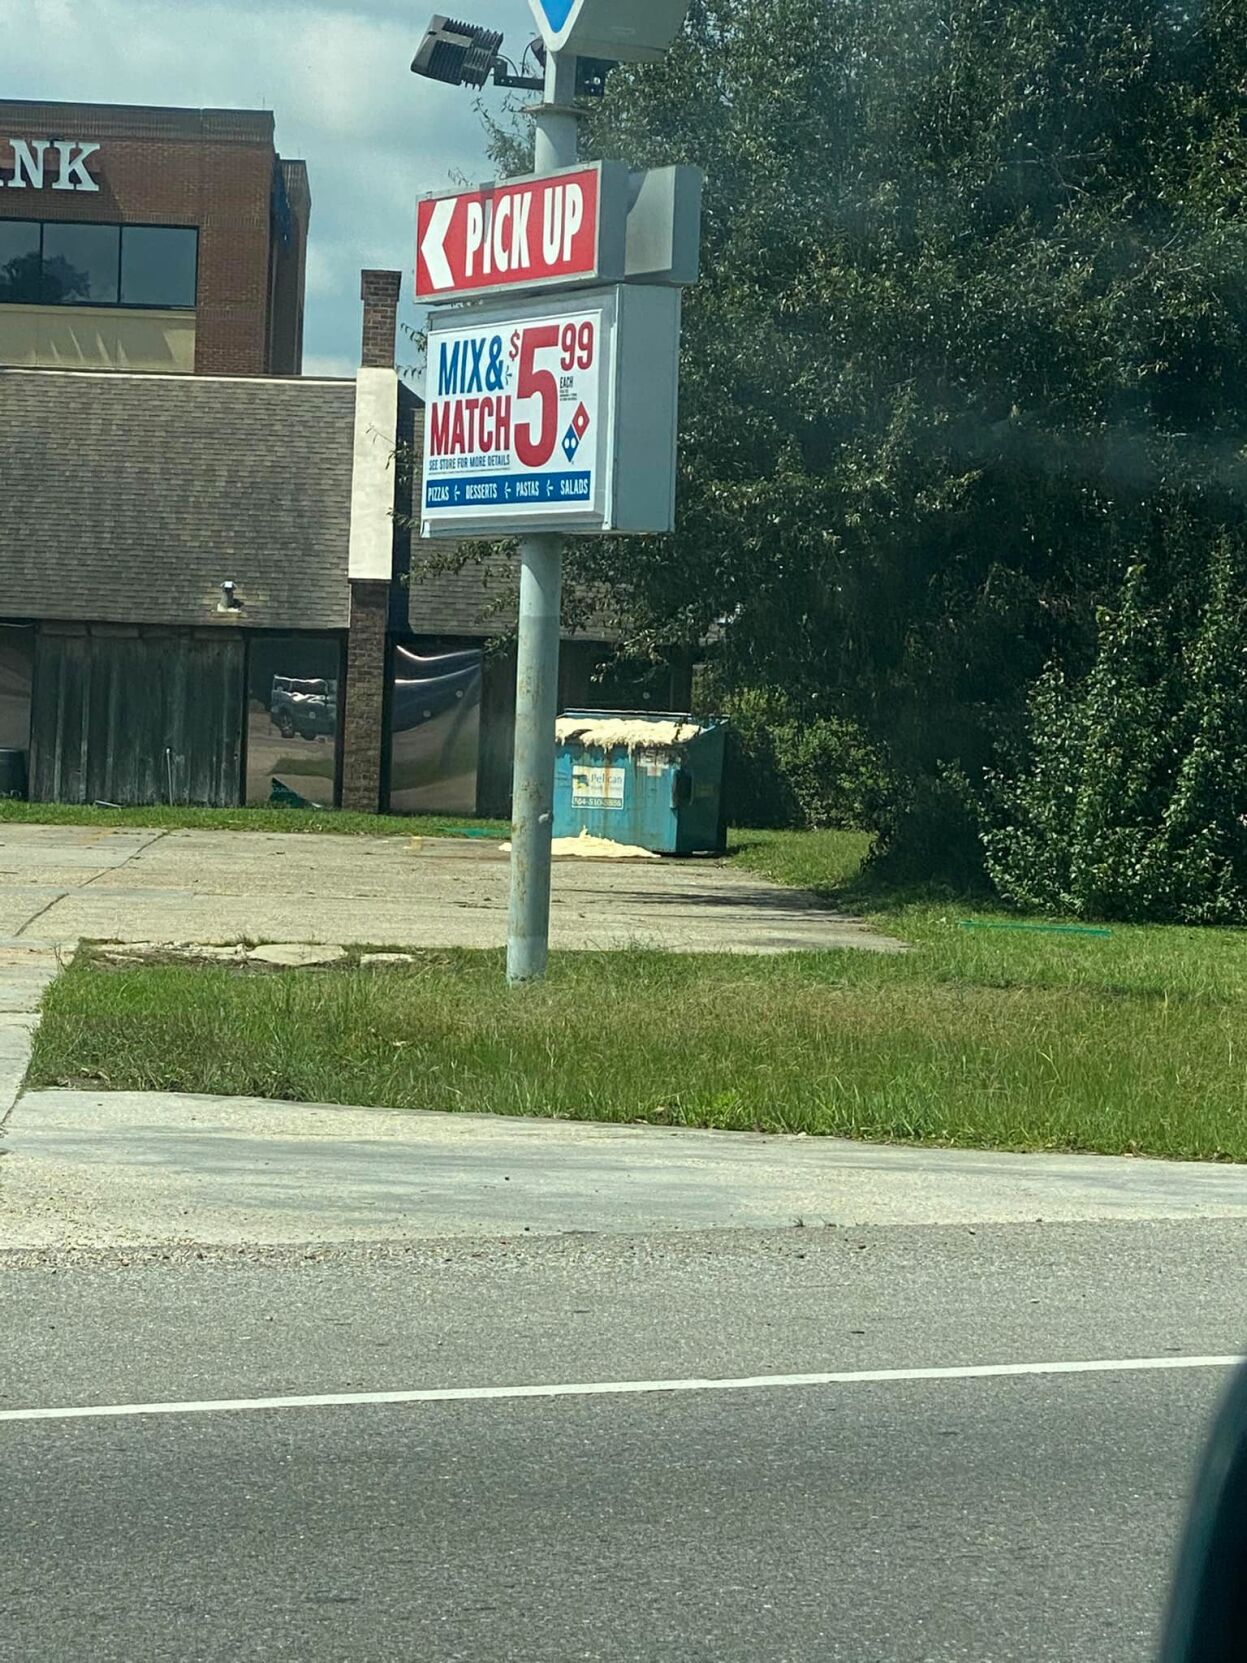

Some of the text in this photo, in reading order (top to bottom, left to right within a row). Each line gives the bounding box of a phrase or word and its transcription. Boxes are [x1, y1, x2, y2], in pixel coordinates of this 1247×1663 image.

[0, 138, 100, 192] NK
[465, 183, 584, 277] PICK UP
[560, 376, 574, 389] EACH
[430, 395, 511, 456] MATCH
[429, 454, 510, 471] SEE STORE FOR MORE DETAILS
[427, 478, 589, 502] PIZZAS DESSERTS PASTAS SALADS
